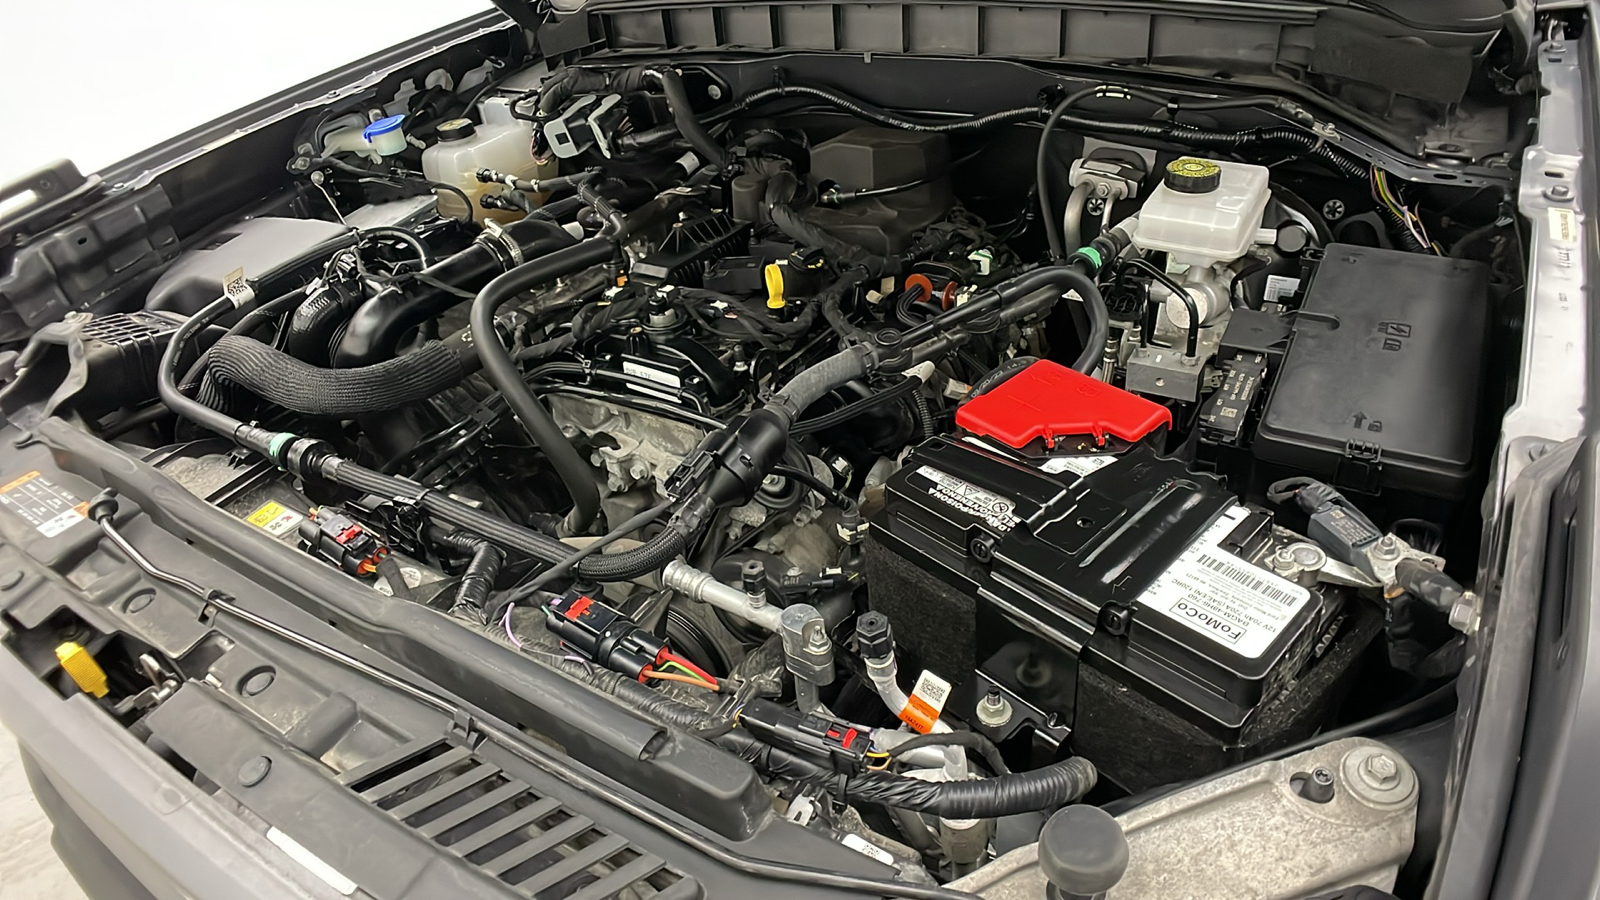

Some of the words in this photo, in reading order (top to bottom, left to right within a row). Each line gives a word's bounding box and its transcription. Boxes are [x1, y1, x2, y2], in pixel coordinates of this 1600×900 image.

[1225, 604, 1244, 617] 720A
[1177, 602, 1242, 640] FoMoCo
[1244, 613, 1263, 627] 70Ah
